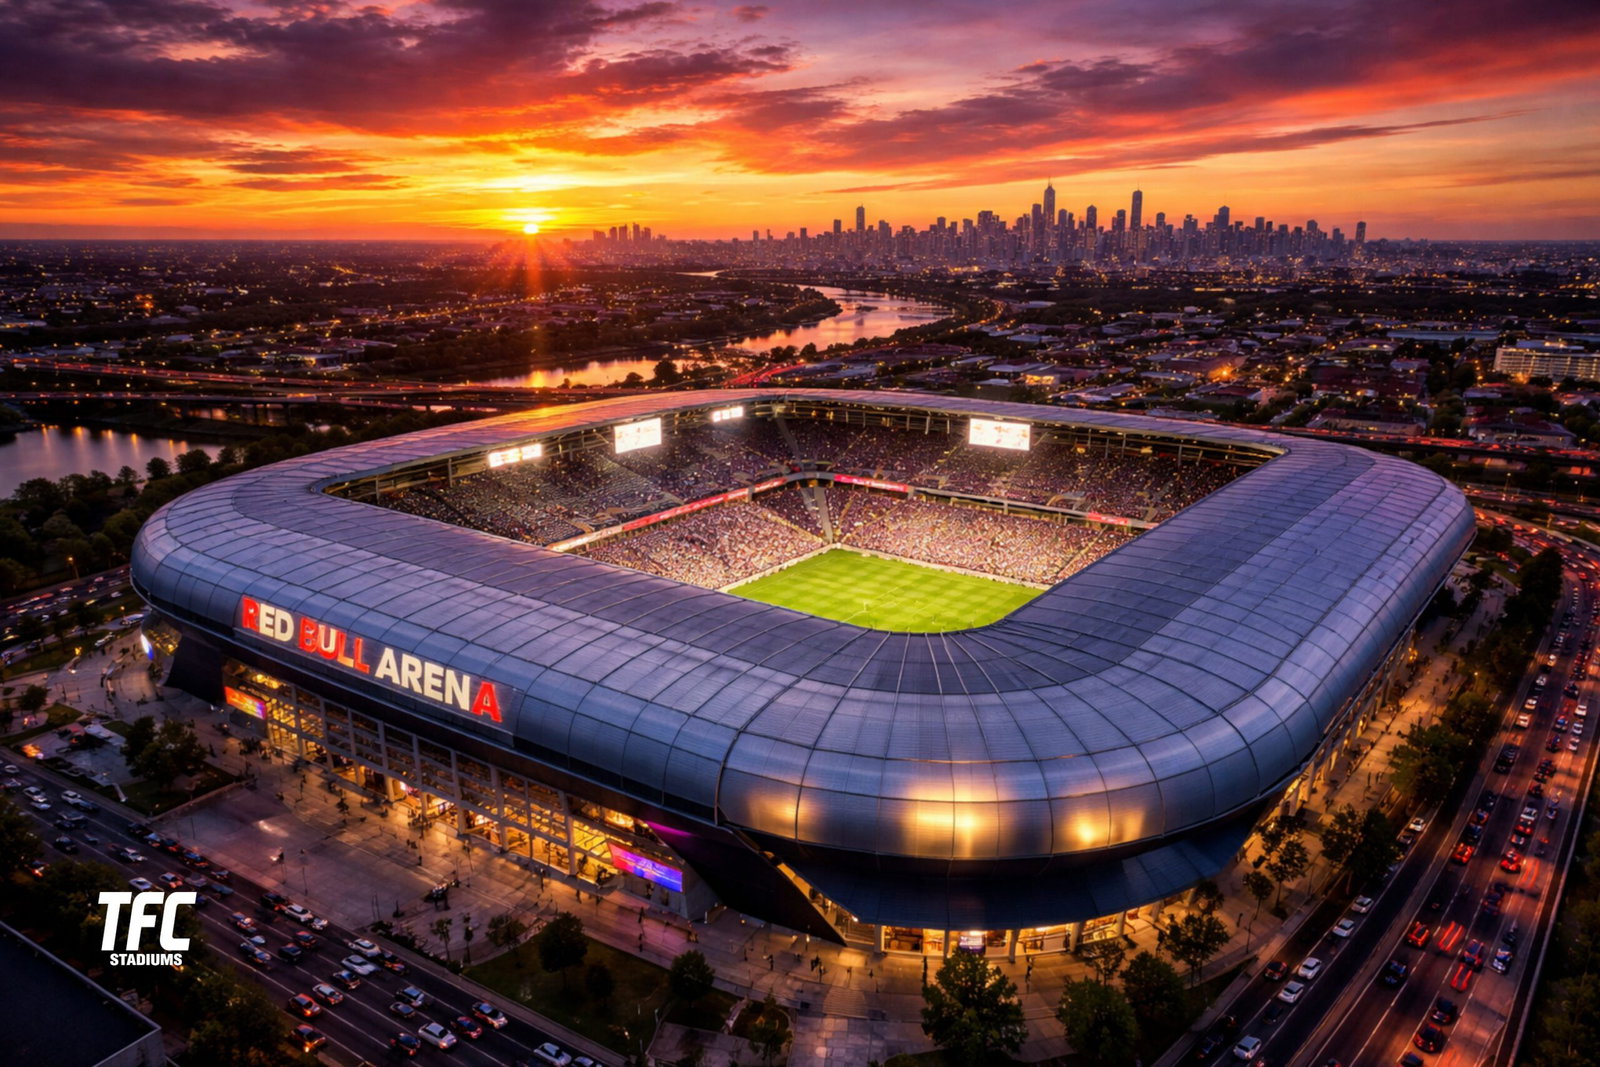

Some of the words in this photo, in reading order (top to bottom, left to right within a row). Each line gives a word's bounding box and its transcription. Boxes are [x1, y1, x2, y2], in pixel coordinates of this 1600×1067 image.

[242, 595, 294, 642] RED
[298, 617, 370, 674] BULL
[375, 647, 502, 722] ARENA
